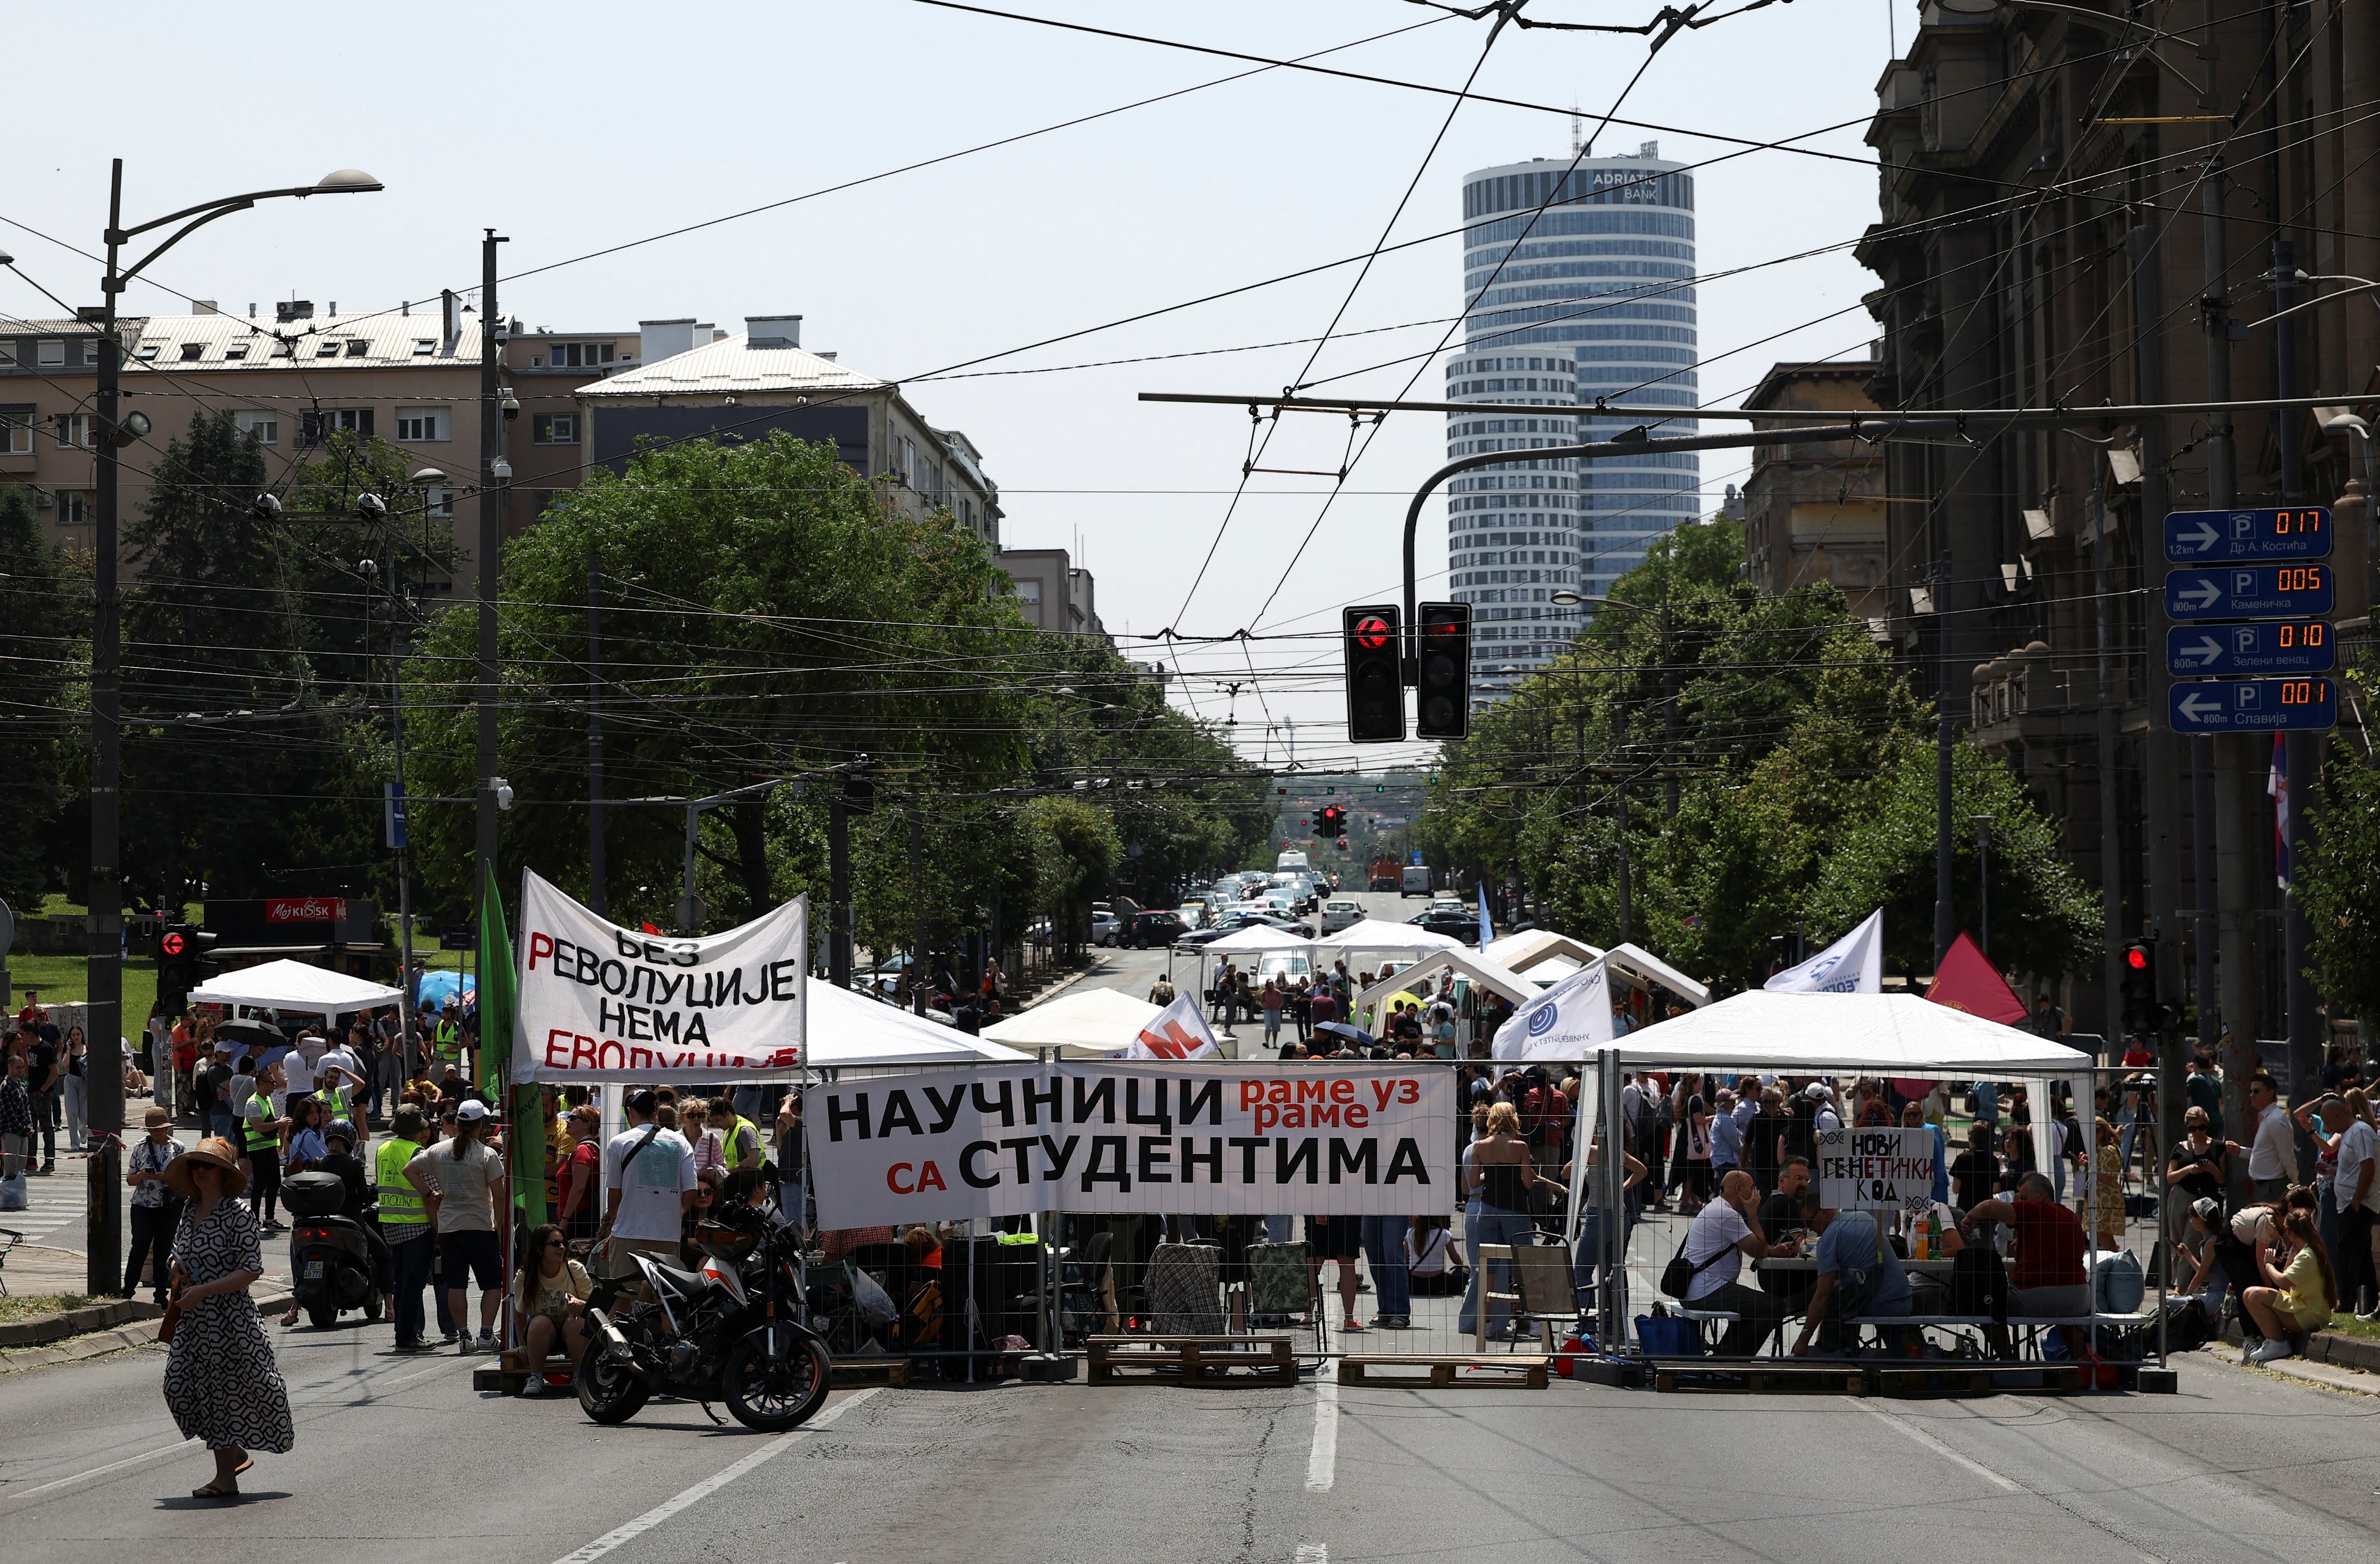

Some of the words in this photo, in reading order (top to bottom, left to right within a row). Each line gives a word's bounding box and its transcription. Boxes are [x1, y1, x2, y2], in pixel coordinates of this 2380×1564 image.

[1625, 189, 1656, 200] BANK
[2276, 511, 2319, 534] 017
[2230, 543, 2244, 554] Др
[2248, 541, 2259, 552] А.
[2263, 540, 2307, 551] Костића
[2278, 568, 2320, 591] 005
[2173, 602, 2197, 612] 800m
[2231, 599, 2291, 610] Каменичка
[2280, 624, 2322, 648] 010
[2174, 659, 2198, 669] 800m
[2233, 656, 2273, 667] Зелени
[2276, 655, 2309, 665] венац
[2282, 683, 2325, 704] 001
[2204, 714, 2228, 724] 800m
[2235, 712, 2287, 726] Славија
[272, 903, 291, 919] Moj
[528, 931, 796, 1008] РЕВОЛУЦИЈЕ
[599, 997, 710, 1047] НЕМА
[1240, 1080, 1355, 1112] раме
[1371, 1080, 1420, 1112] уз
[827, 1076, 1222, 1142] НАУЧНИЦИ
[1254, 1103, 1369, 1136] раме
[1852, 1133, 1902, 1157] НОВИ
[887, 1160, 947, 1194] СА
[959, 1134, 1431, 1193] СТУДЕНТИМА
[1856, 1179, 1900, 1203] КОД
